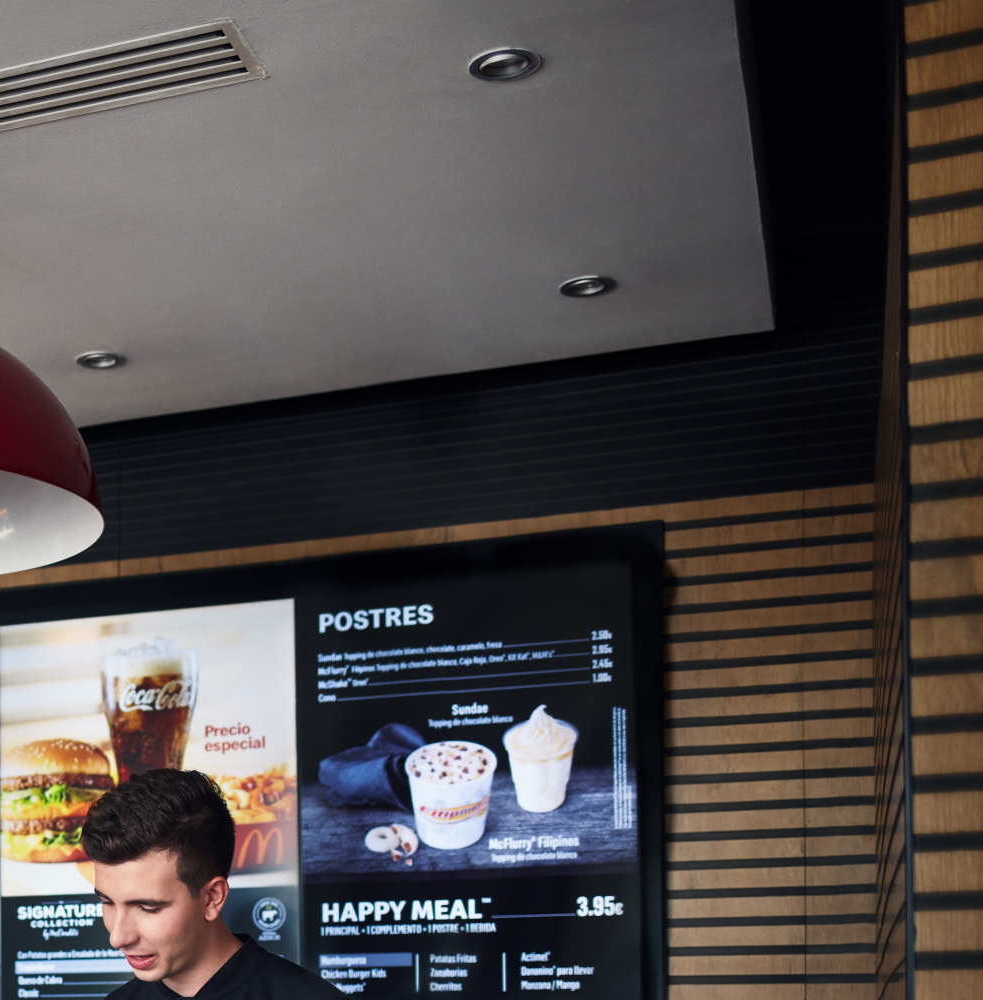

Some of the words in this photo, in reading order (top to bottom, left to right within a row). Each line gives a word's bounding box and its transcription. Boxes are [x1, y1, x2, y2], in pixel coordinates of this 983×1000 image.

[318, 604, 434, 634] POSTRES
[119, 679, 191, 713] Coca-Cola
[451, 702, 489, 716] Sundae
[428, 718, 452, 729] Topping
[452, 718, 461, 727] de
[461, 716, 492, 726] chocolate
[492, 715, 514, 723] blanco
[204, 722, 251, 738] Precio
[204, 736, 266, 754] especial
[538, 835, 580, 850] Filipinos
[17, 903, 103, 920] SIGNATURE
[321, 900, 406, 923] HAPPY
[576, 895, 624, 917] 3.95€
[30, 918, 94, 929] COLLECTION
[325, 926, 360, 936] PRINCIPAL
[370, 924, 422, 935] COMPLEMENTO
[432, 923, 460, 934] POSTRE
[470, 922, 497, 933] BEBIDA
[320, 955, 367, 967] Hamburguesa
[429, 953, 456, 964] Patatas
[456, 953, 478, 964] Fritas
[321, 968, 348, 980] Chicken
[348, 968, 371, 980] Burger
[371, 967, 387, 979] Kids
[429, 967, 468, 978] Zanahorias
[556, 967, 573, 977] para
[574, 965, 595, 976] llevar
[429, 981, 462, 992] Cherritos
[520, 980, 551, 990] Manzana
[556, 979, 581, 991] Mango
